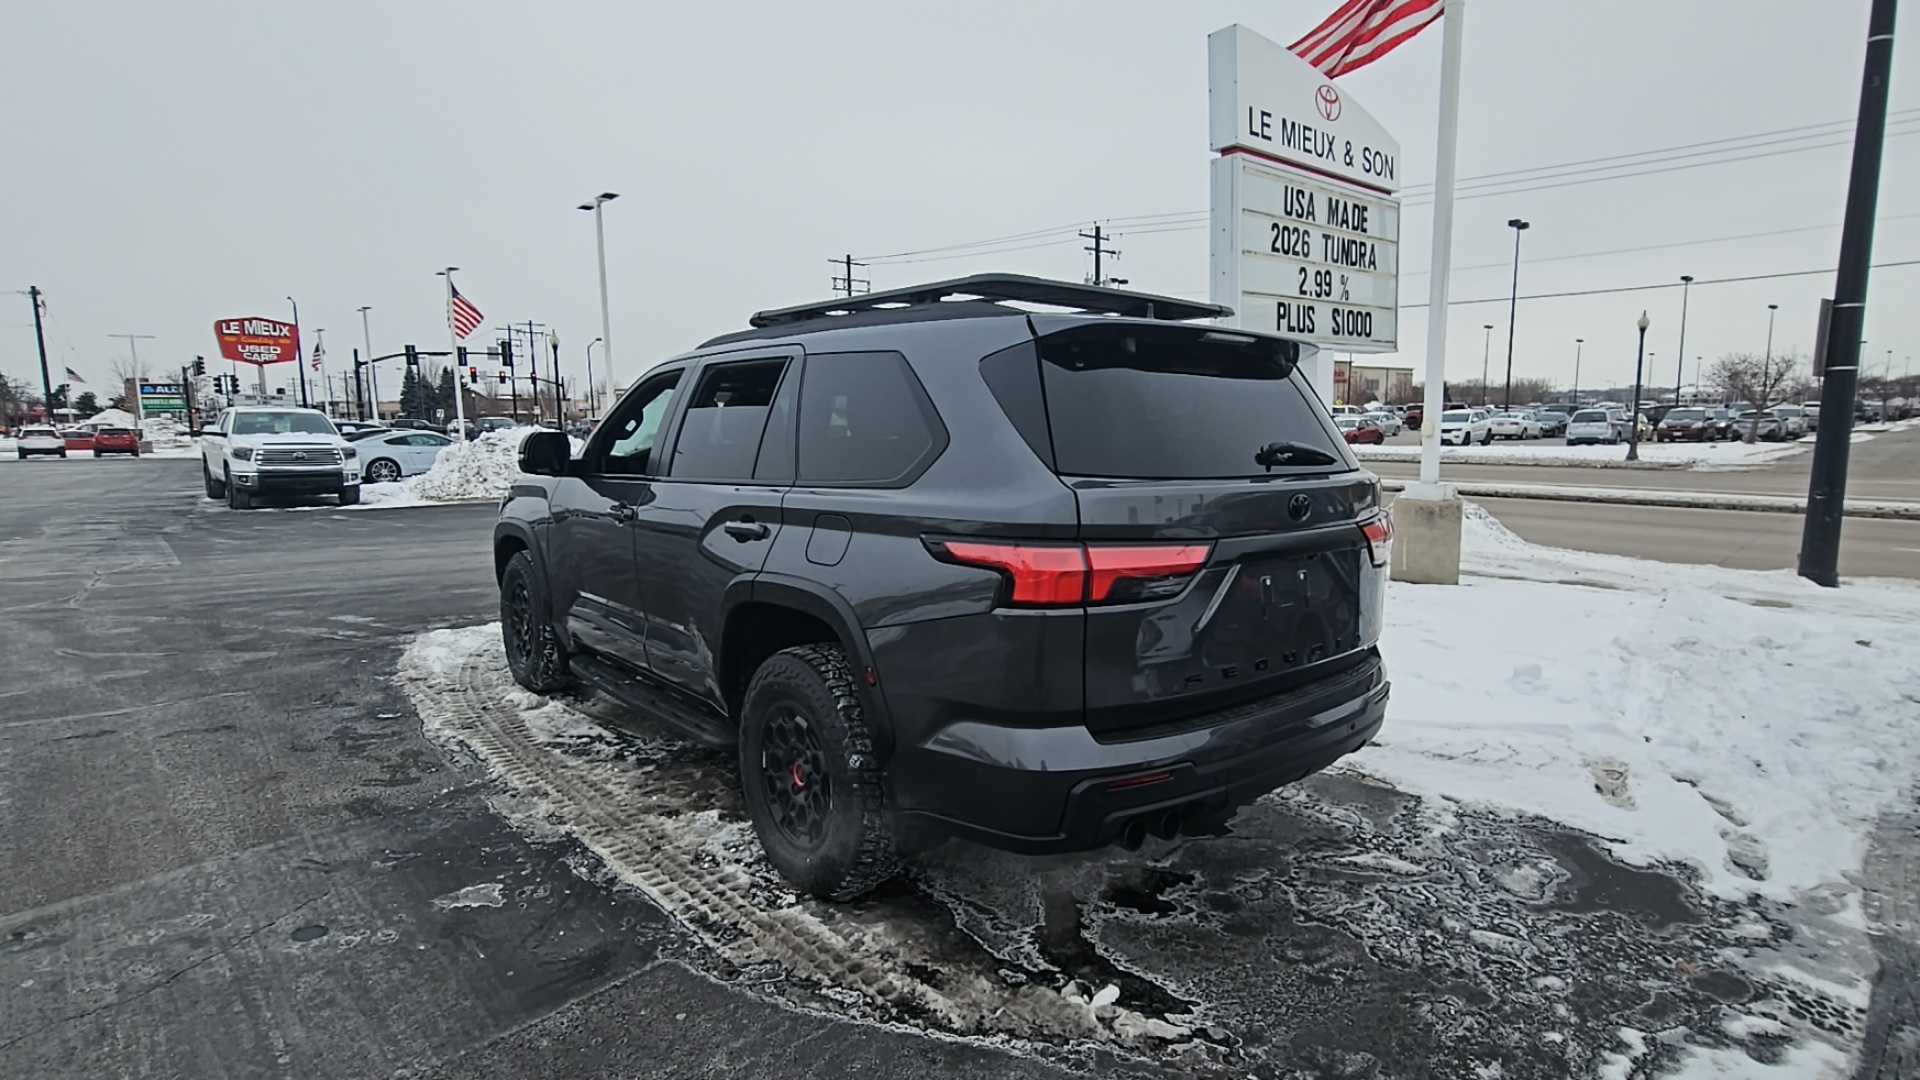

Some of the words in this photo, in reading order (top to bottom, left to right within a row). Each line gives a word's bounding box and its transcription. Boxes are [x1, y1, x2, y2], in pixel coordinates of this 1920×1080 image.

[1248, 105, 1272, 141] LE
[1281, 117, 1336, 162] MIEUX
[1343, 139, 1355, 168] &
[1361, 146, 1394, 181] SON
[1283, 185, 1316, 222] USA
[1326, 196, 1369, 234] MADE
[1270, 222, 1311, 259] 2026
[1321, 233, 1377, 271] TUNDRA
[1298, 267, 1332, 298] 2.99
[1339, 273, 1350, 301] %
[221, 322, 241, 335] LE
[243, 320, 291, 337] MIEUX
[1276, 301, 1315, 334] PLUS
[237, 344, 282, 354] USED
[243, 353, 278, 362] CARS
